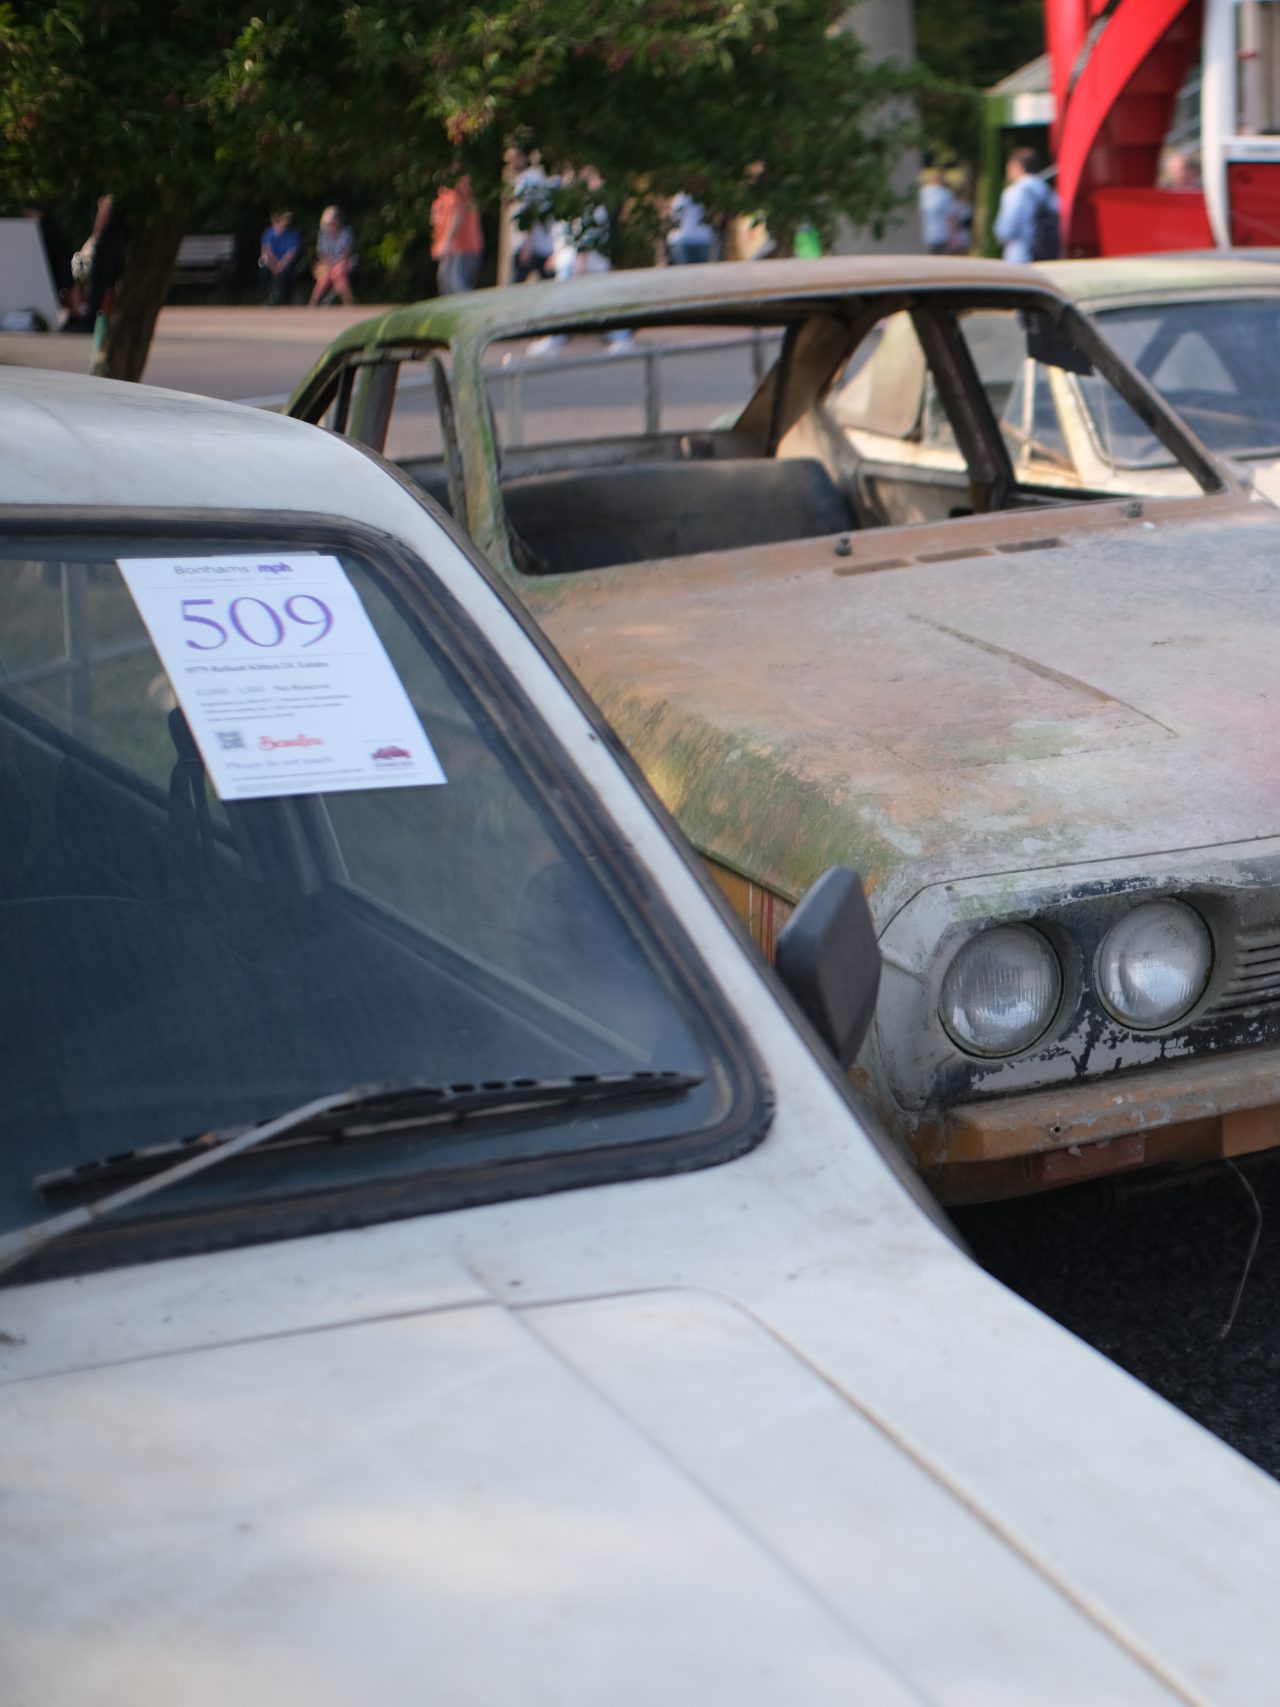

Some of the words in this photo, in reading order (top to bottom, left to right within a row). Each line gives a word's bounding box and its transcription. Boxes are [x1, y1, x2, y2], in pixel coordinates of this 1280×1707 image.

[173, 564, 250, 576] Bonhams
[257, 561, 293, 575] mph
[180, 594, 334, 650] 509
